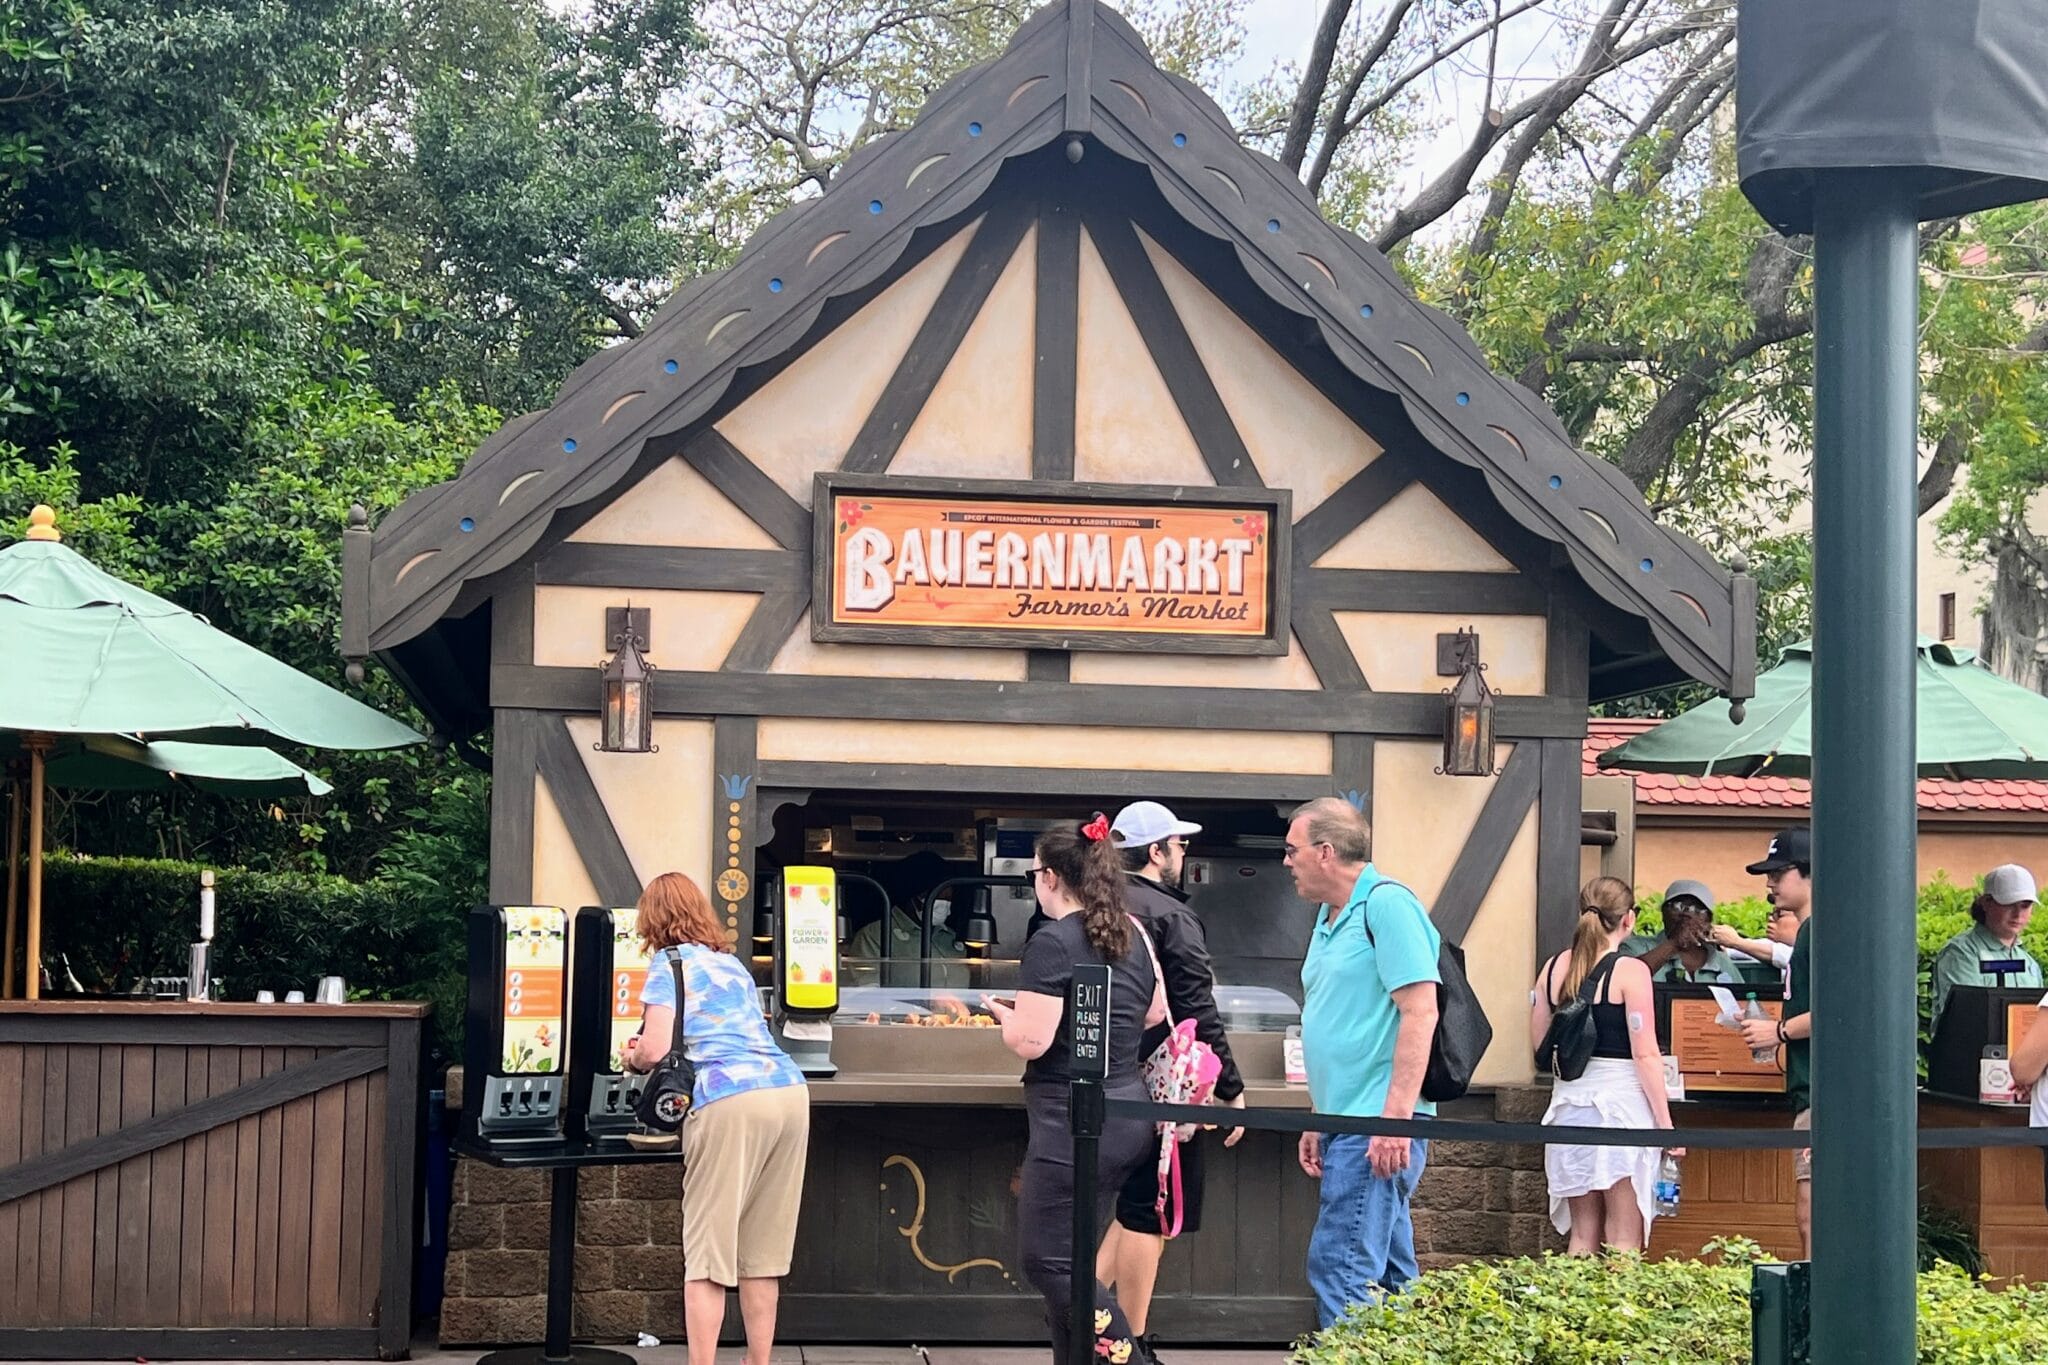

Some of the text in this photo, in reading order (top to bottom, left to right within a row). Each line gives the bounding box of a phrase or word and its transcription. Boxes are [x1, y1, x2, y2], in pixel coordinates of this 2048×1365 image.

[963, 514, 987, 522] EPCOT
[987, 515, 1042, 524] INTERNATIONAL
[1043, 517, 1071, 525] FLOWER
[1111, 519, 1140, 527] FESTIVAL
[845, 527, 1254, 612] BAUERNMARKT
[1008, 593, 1248, 620] Farmer's Market
[1077, 984, 1102, 1007] EXIT
[1076, 1011, 1100, 1026] PLEASE
[1076, 1027, 1100, 1042] DO NOT
[1076, 1043, 1098, 1058] ENTER
